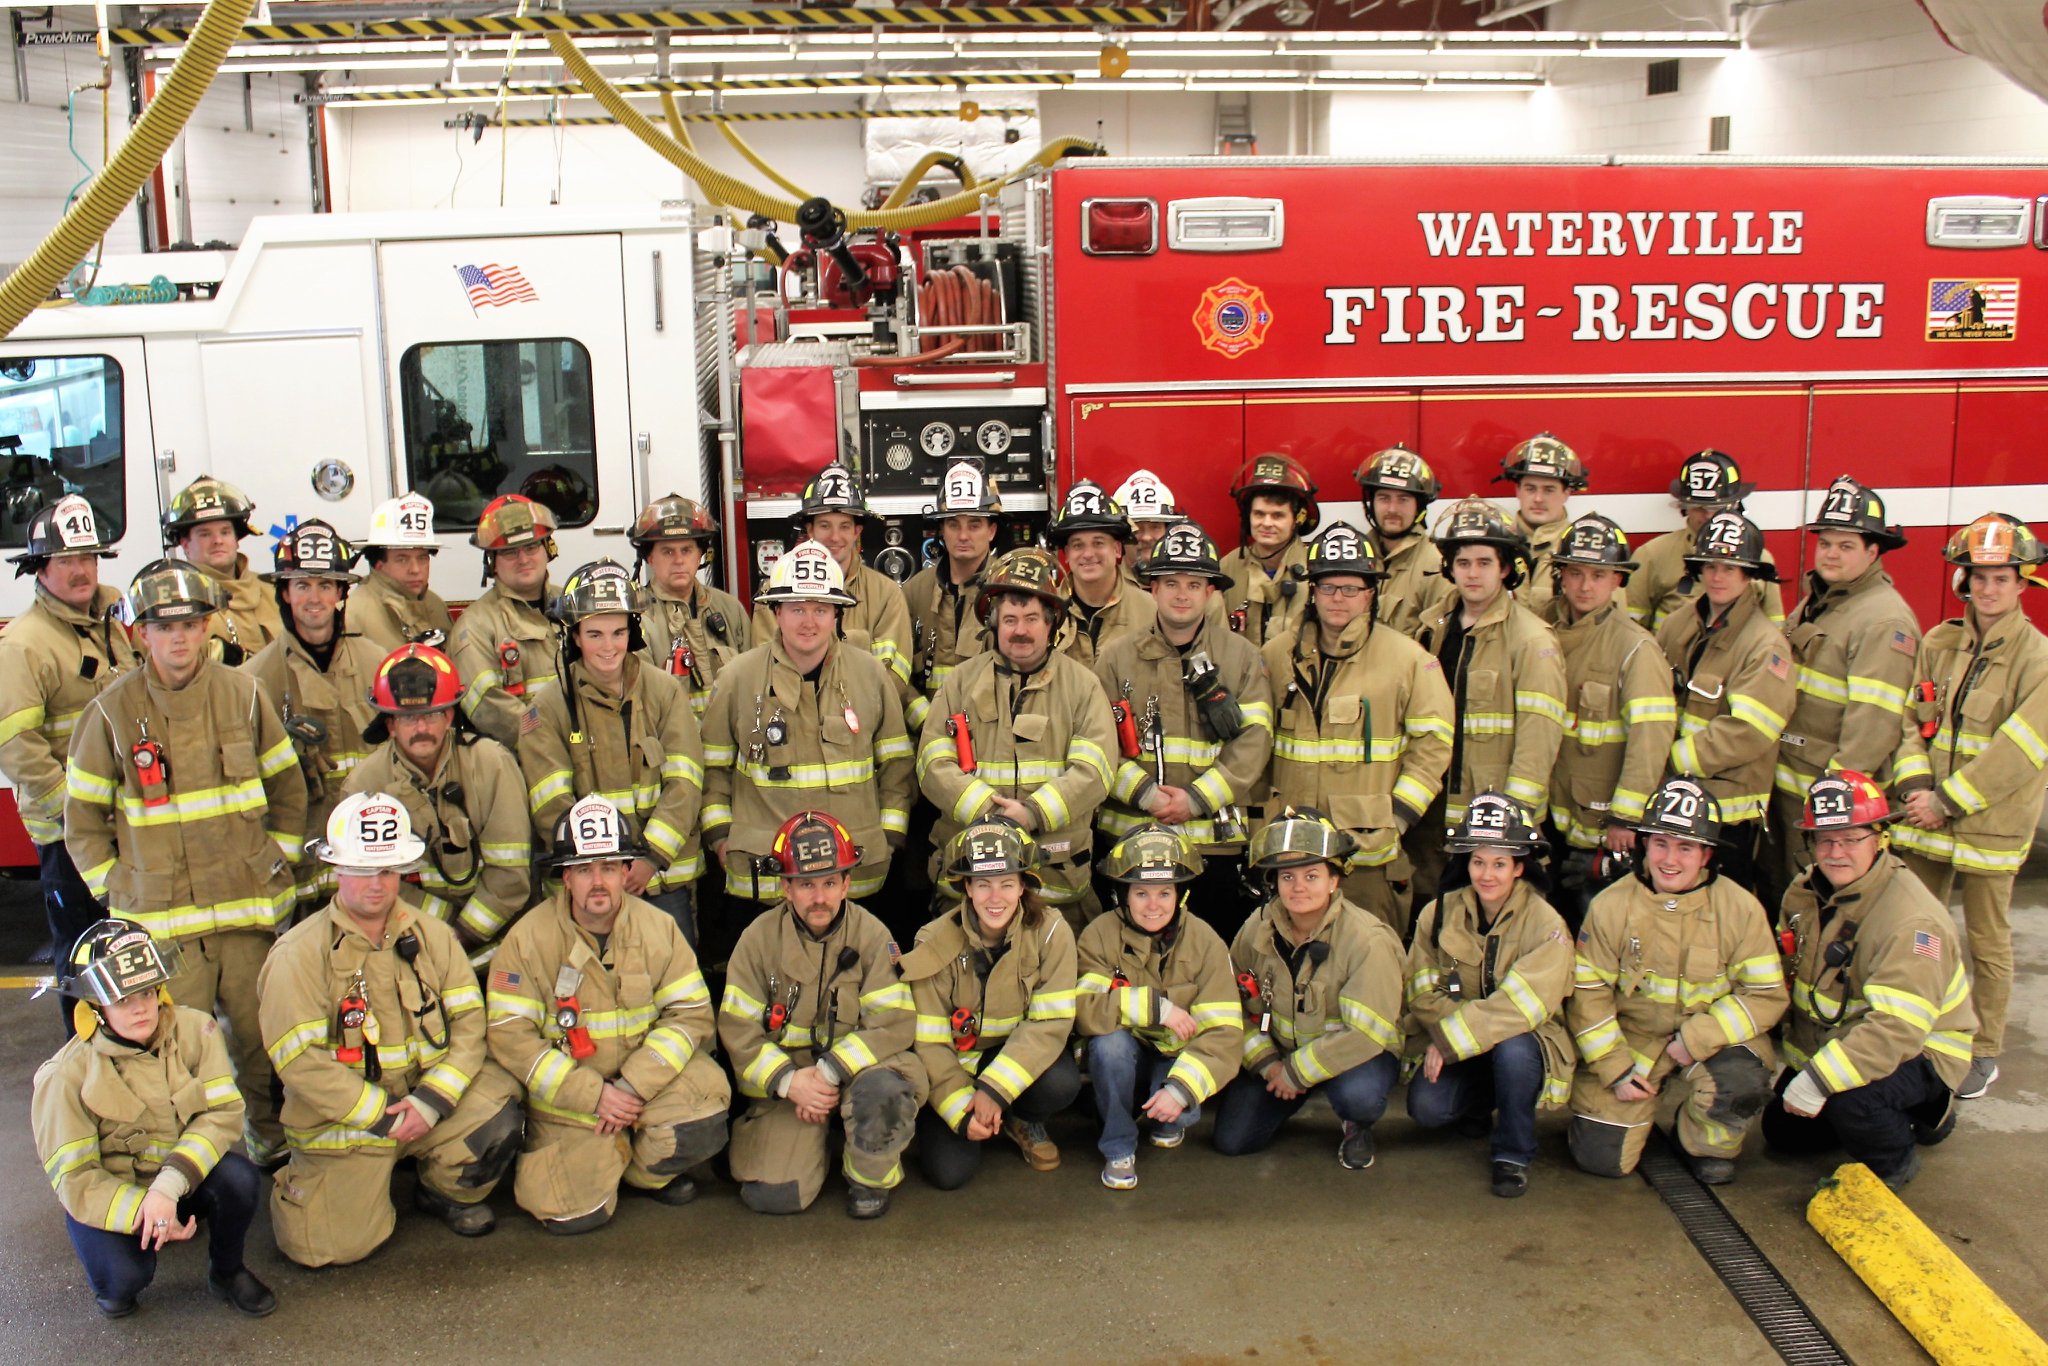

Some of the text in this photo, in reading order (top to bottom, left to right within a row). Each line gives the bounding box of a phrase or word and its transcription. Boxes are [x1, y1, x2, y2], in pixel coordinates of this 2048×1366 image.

[1418, 211, 1804, 257] WATERVILLE
[1531, 447, 1556, 464] E-1
[1254, 463, 1283, 477] E-2
[1380, 460, 1411, 478] E-2
[821, 478, 850, 497] 73
[951, 481, 976, 497] 51
[1689, 472, 1720, 490] 57
[194, 493, 223, 509] E-1
[1131, 488, 1157, 504] 42
[1828, 492, 1853, 513] 71
[1070, 496, 1101, 516] 64
[66, 516, 94, 534] 40
[400, 513, 427, 530] 45
[1458, 514, 1484, 527] E-1
[1574, 532, 1605, 549] E-2
[1710, 523, 1743, 545] 72
[297, 538, 334, 560] 62
[1167, 536, 1201, 556] 63
[1325, 540, 1358, 561] 65
[795, 560, 827, 581] 55
[1015, 561, 1042, 581] E-1
[365, 806, 392, 815] CAPTAIN
[577, 804, 611, 817] LIEUTENANT
[1664, 791, 1697, 818] 70
[1814, 794, 1847, 814] E-1
[1471, 809, 1505, 827] E-2
[361, 819, 398, 842] 52
[579, 818, 613, 840] 61
[797, 838, 832, 861] E-2
[971, 839, 1005, 860] E-1
[1141, 850, 1172, 868] E-1
[116, 946, 155, 975] E-1
